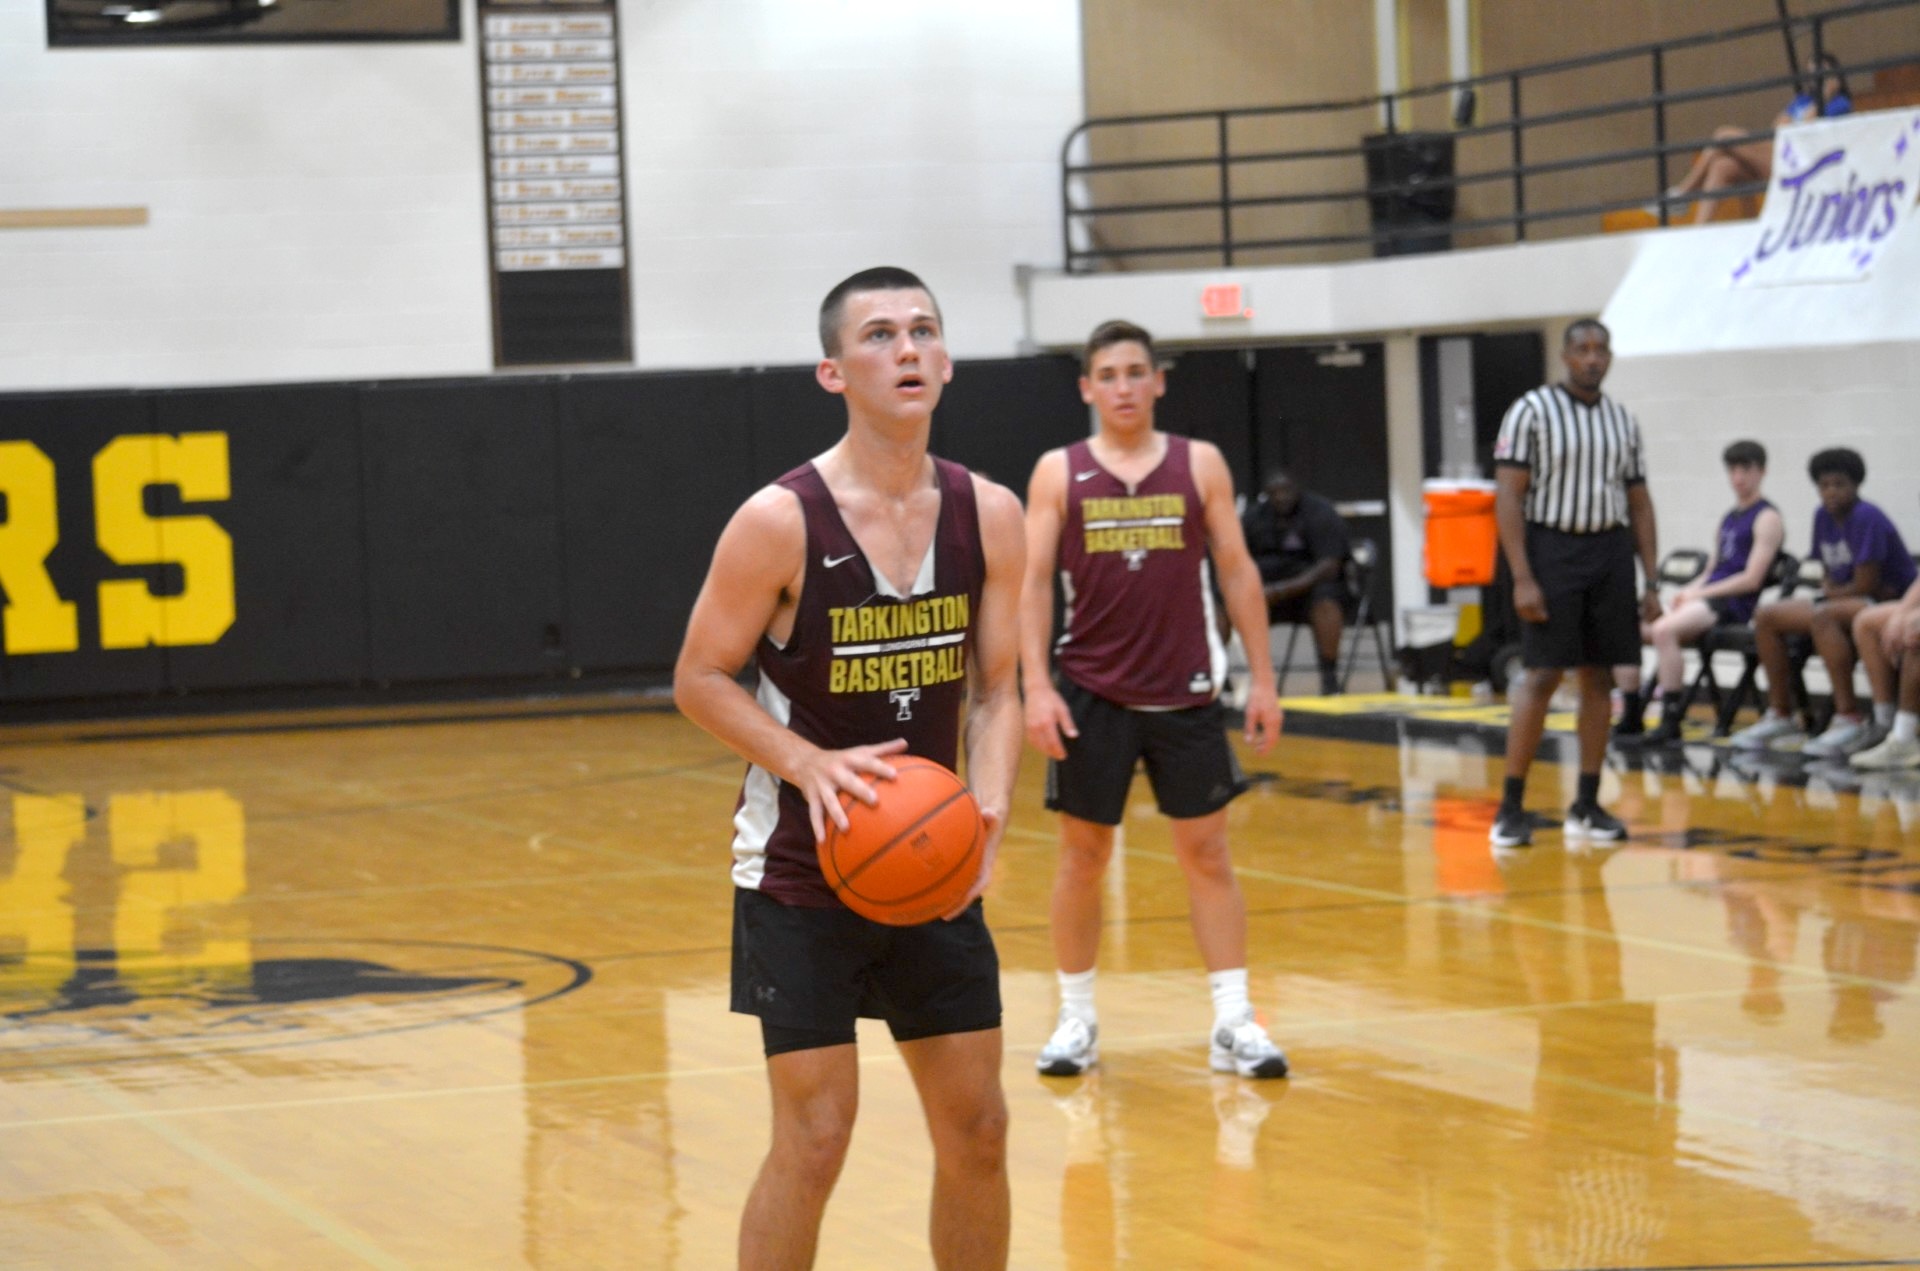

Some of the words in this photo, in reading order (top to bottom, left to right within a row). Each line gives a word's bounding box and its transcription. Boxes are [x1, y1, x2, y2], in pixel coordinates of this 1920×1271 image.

[1755, 149, 1905, 262] Juniors
[828, 593, 970, 644] TARKINGTON
[829, 646, 965, 693] BASKETBALL
